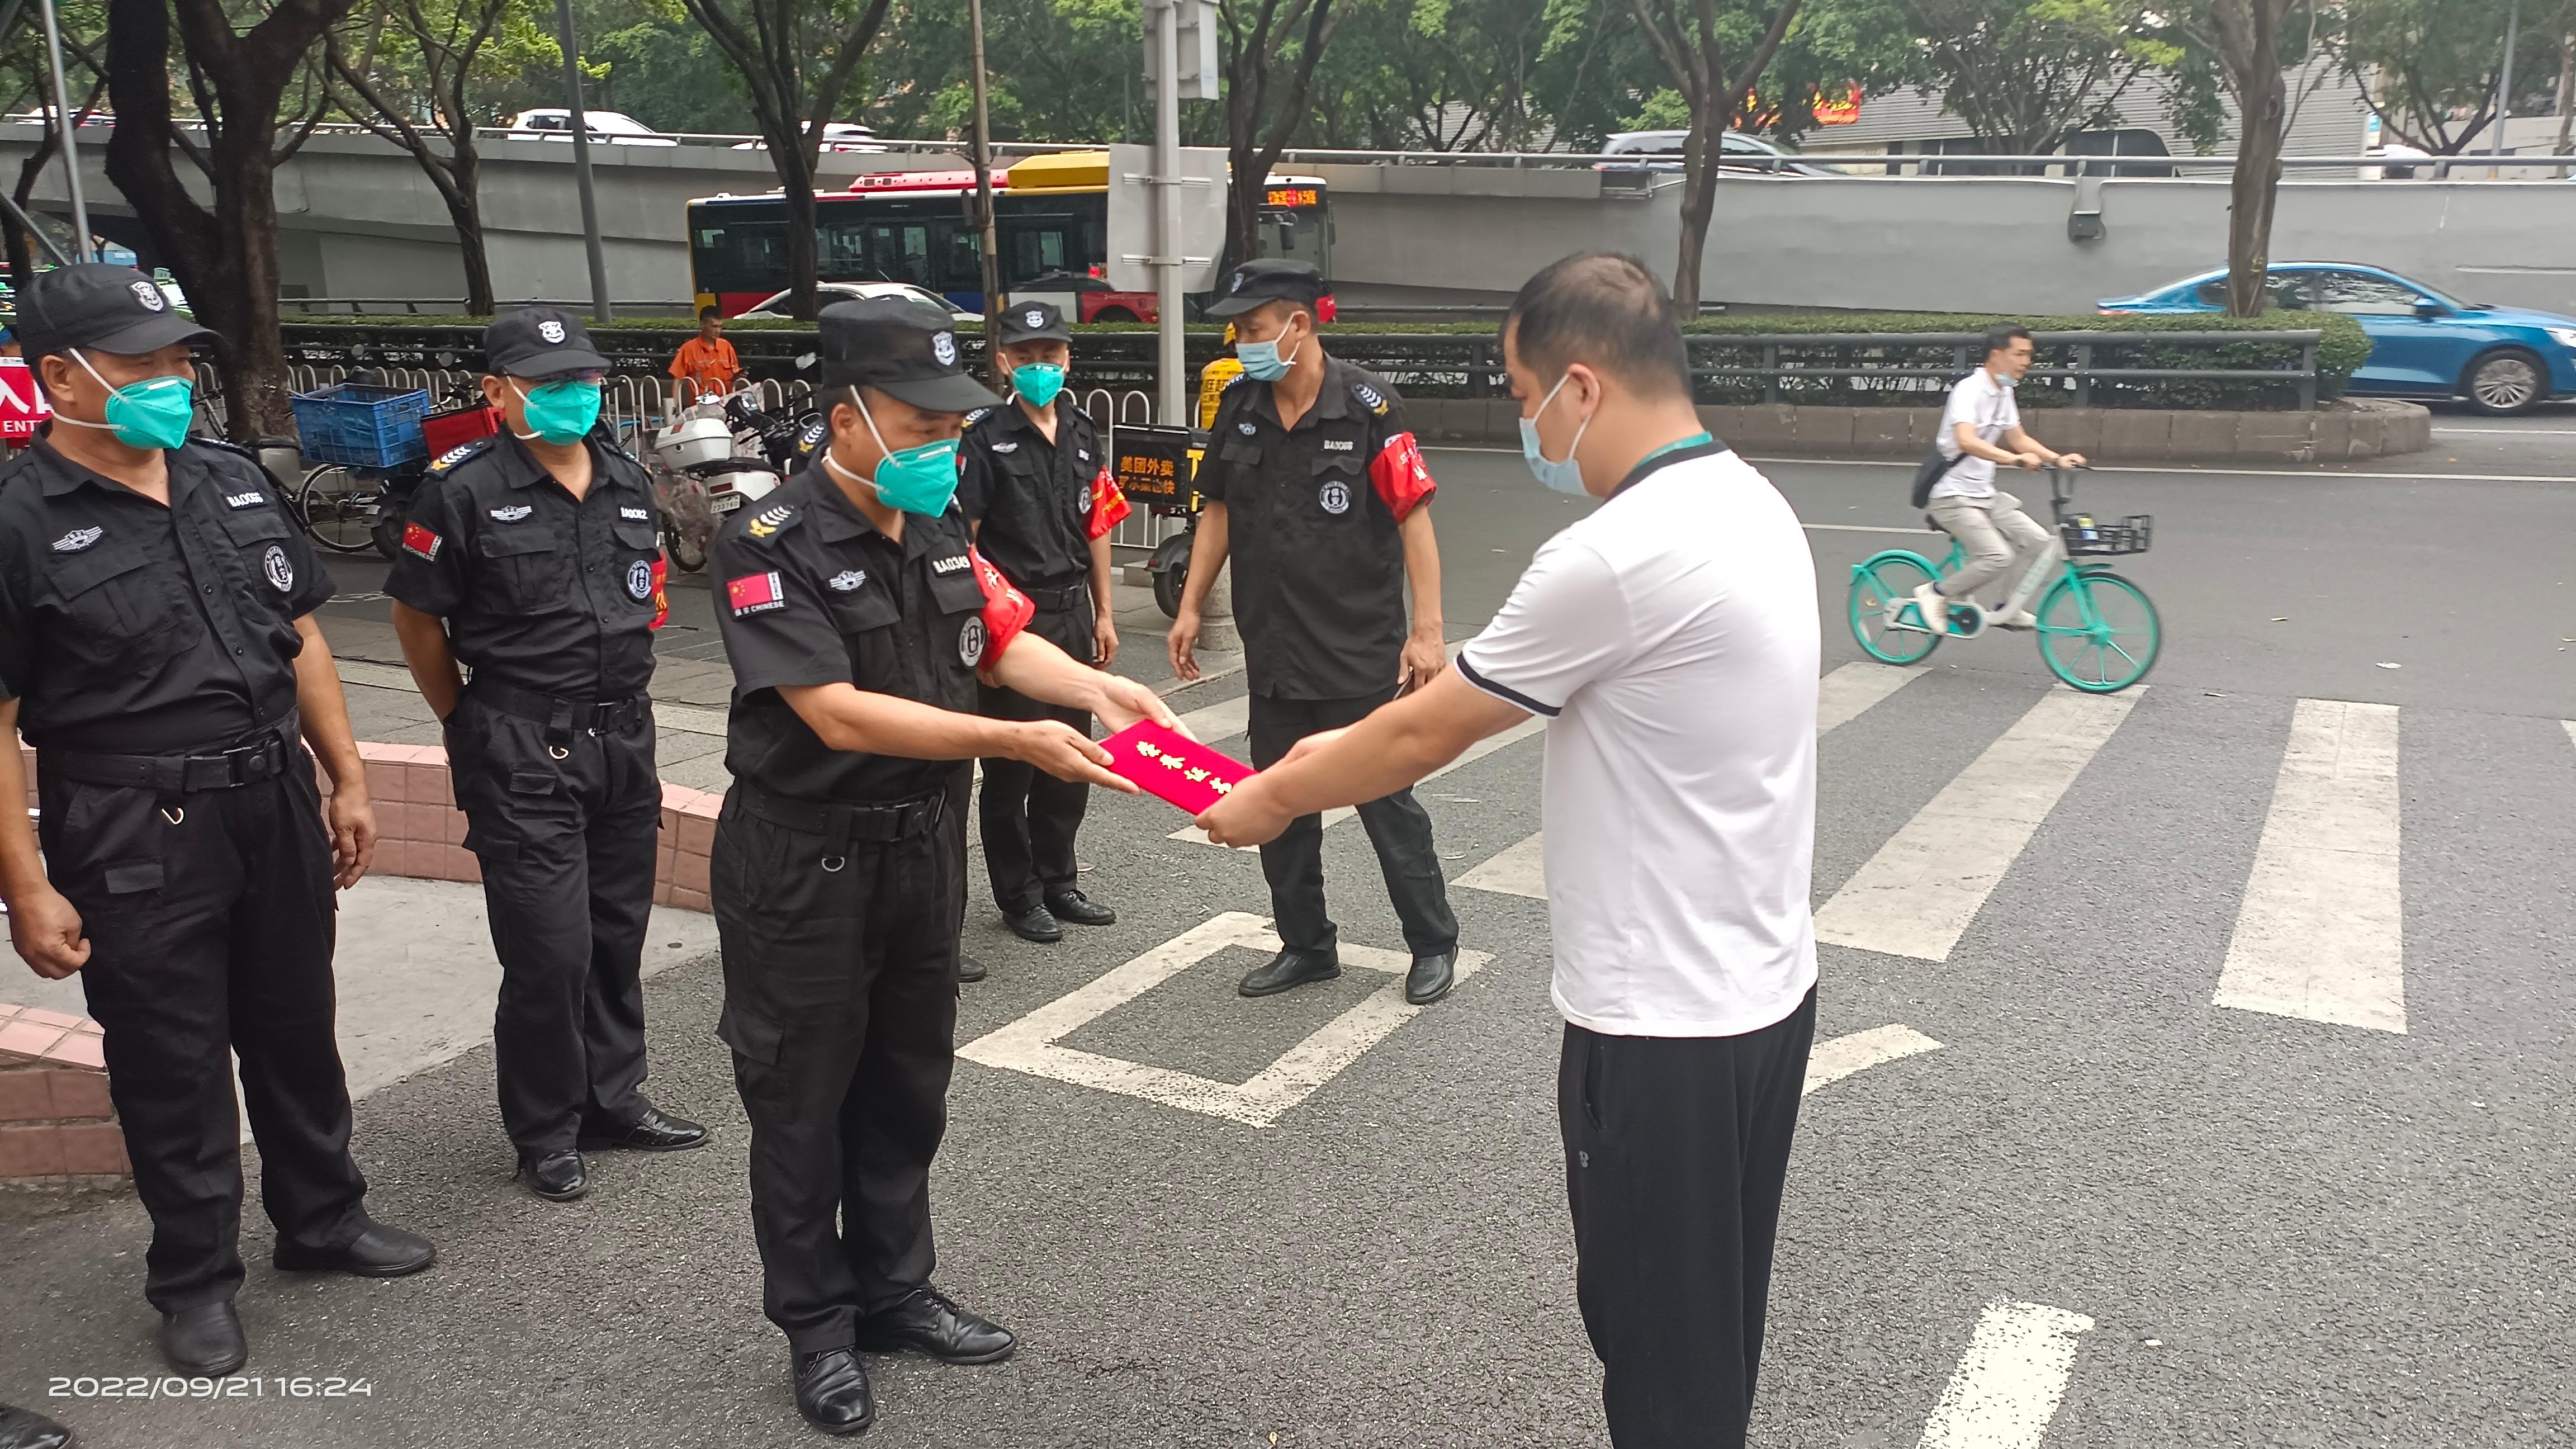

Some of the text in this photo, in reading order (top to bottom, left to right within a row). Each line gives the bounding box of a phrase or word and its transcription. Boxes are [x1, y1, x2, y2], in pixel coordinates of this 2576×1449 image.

[3, 420, 42, 433] ENT
[1120, 456, 1174, 476] 美团外卖
[750, 600, 785, 612] CHINESE
